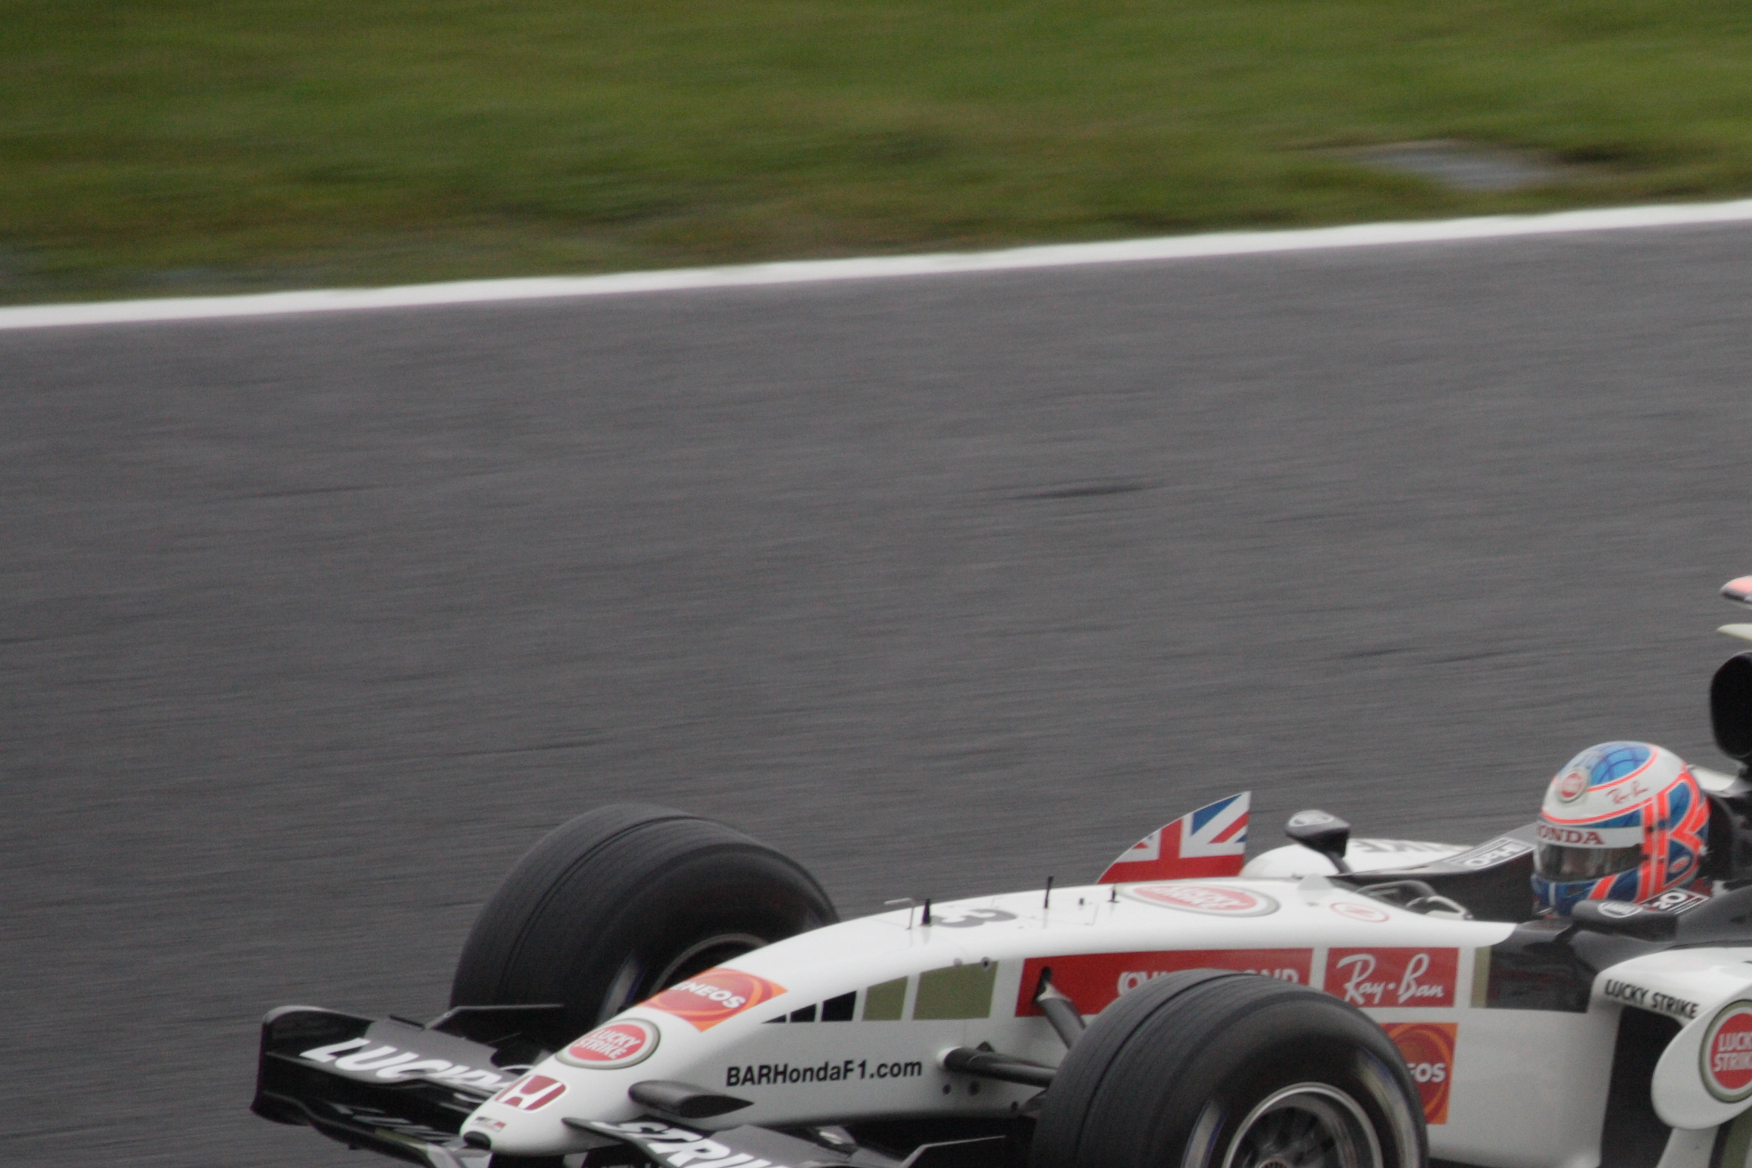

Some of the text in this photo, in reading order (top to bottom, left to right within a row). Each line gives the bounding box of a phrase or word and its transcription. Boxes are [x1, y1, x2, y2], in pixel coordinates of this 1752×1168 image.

[1537, 823, 1606, 845] ONDA
[1604, 979, 1700, 1020] LUCKY STRIKE
[573, 1038, 628, 1059] STRIKE
[587, 1029, 642, 1050] LUCKY
[725, 1058, 923, 1088] BARHondaF1.com
